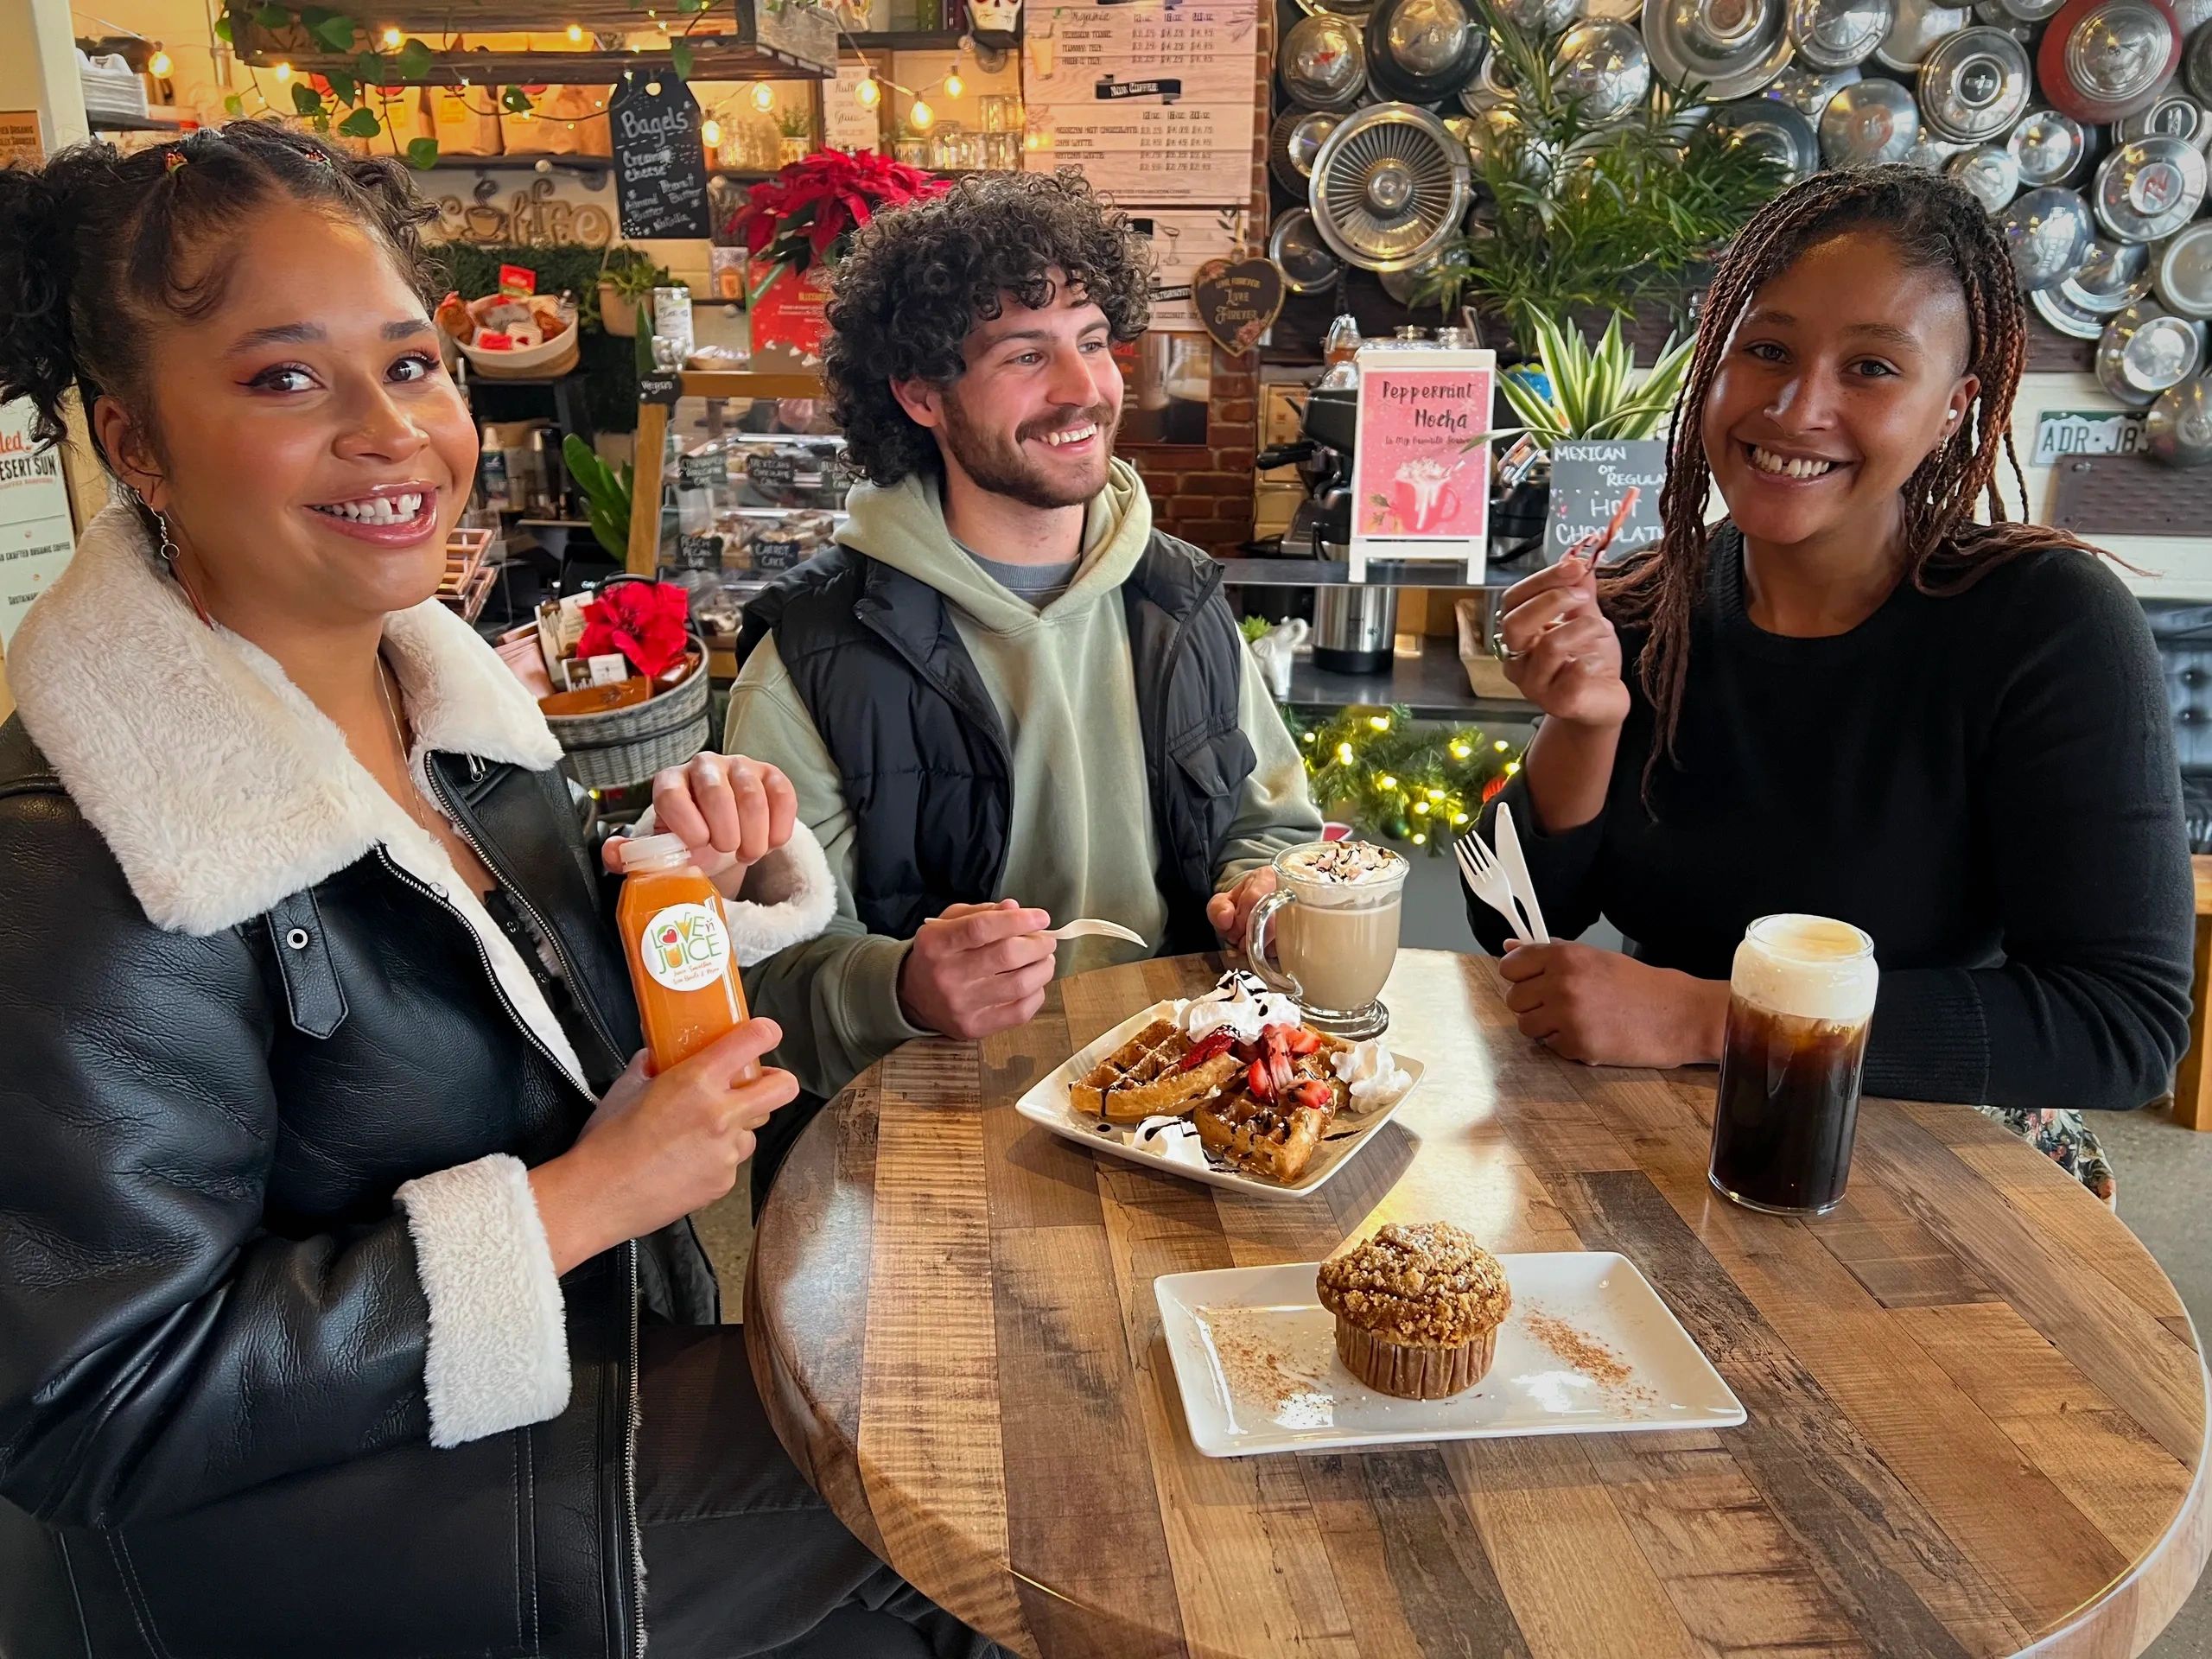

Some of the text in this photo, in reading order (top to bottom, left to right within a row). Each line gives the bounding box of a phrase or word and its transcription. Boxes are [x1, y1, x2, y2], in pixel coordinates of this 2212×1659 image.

[621, 107, 689, 148] Bagels
[641, 380, 673, 394] Vegan
[1415, 409, 1467, 433] Mocha
[35, 455, 57, 475] SUN
[1554, 446, 1627, 462] MEXICAN
[651, 912, 705, 949] LOVE
[659, 933, 722, 974] JUICE
